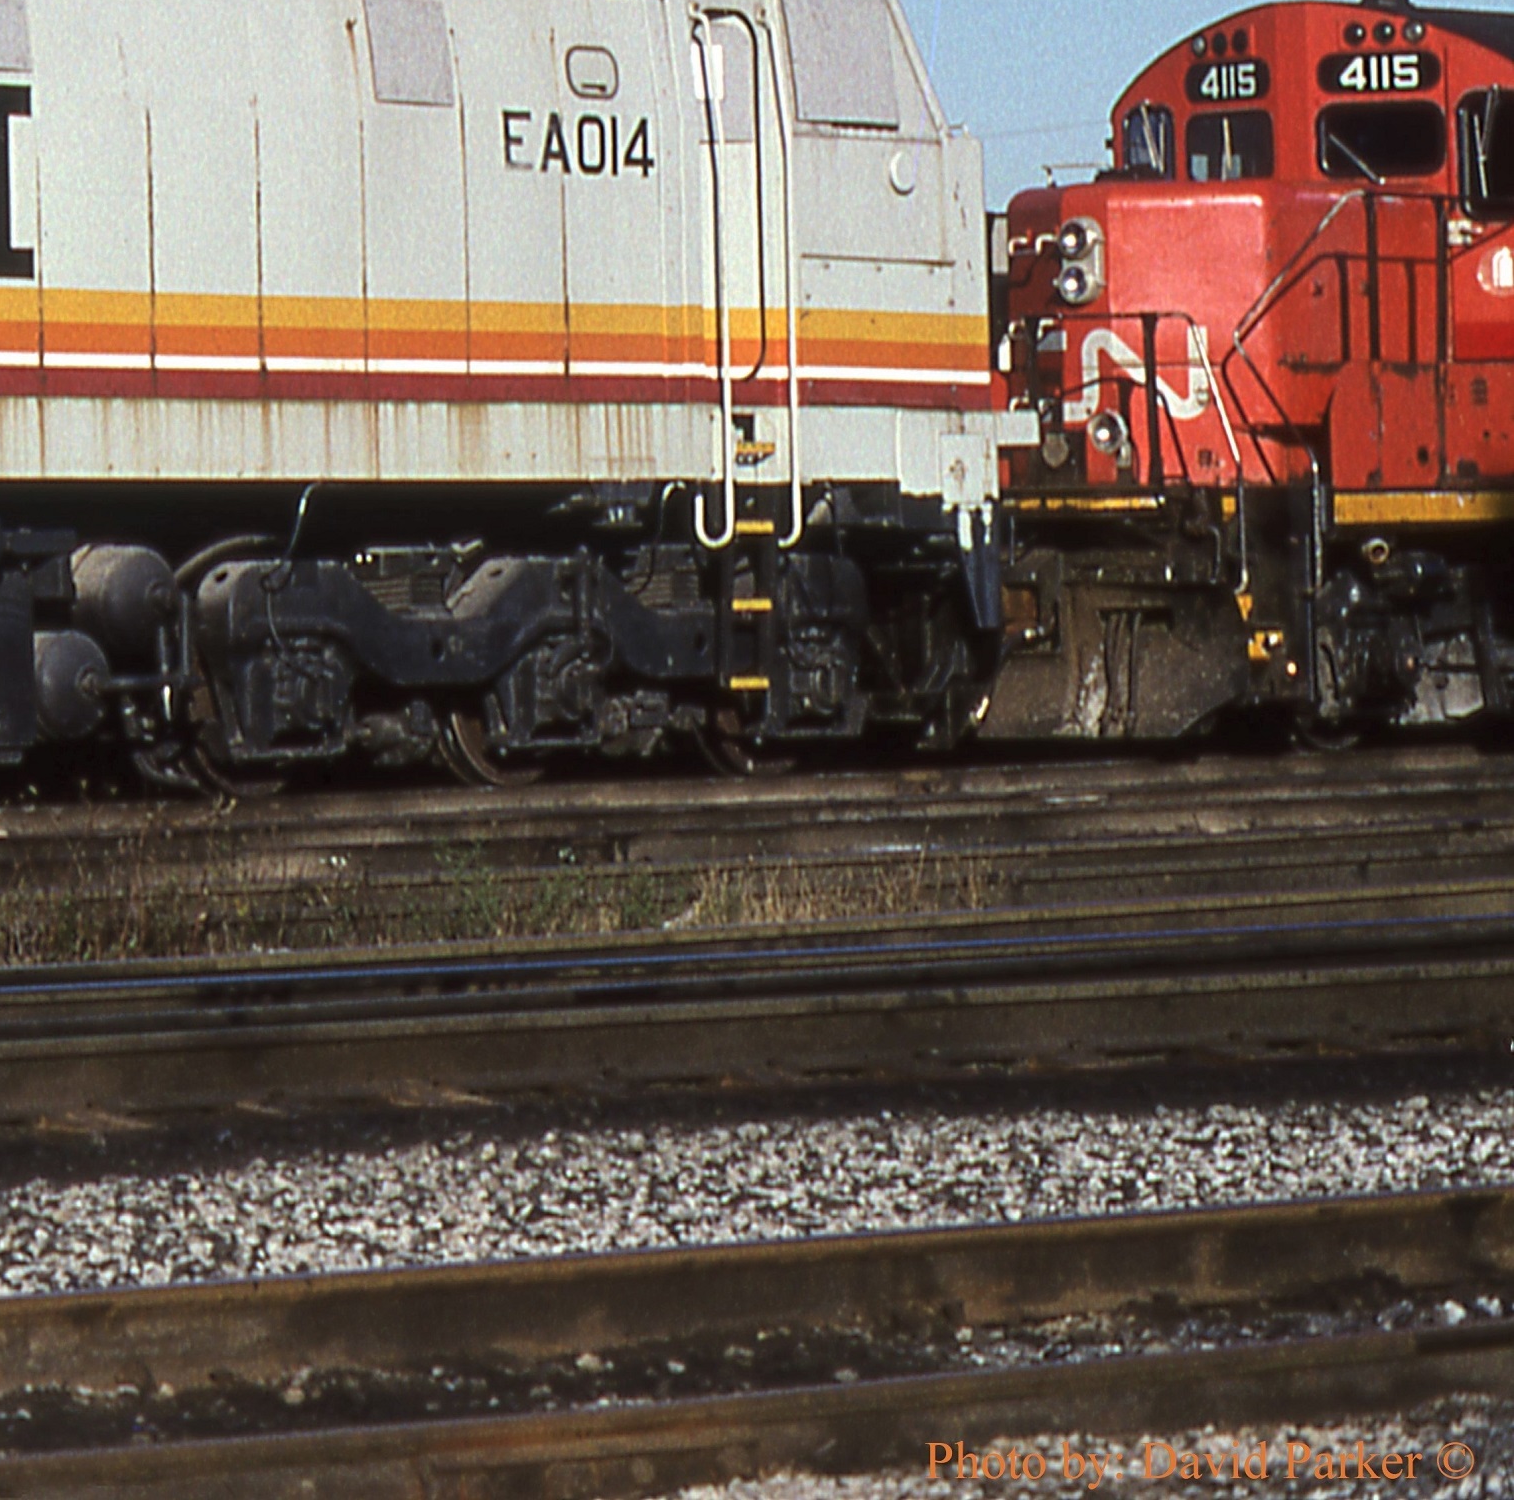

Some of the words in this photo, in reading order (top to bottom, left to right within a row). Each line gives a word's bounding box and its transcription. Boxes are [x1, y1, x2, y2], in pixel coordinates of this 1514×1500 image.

[1201, 63, 1256, 100] 4115
[1340, 54, 1419, 90] 4115
[501, 110, 655, 179] EA014
